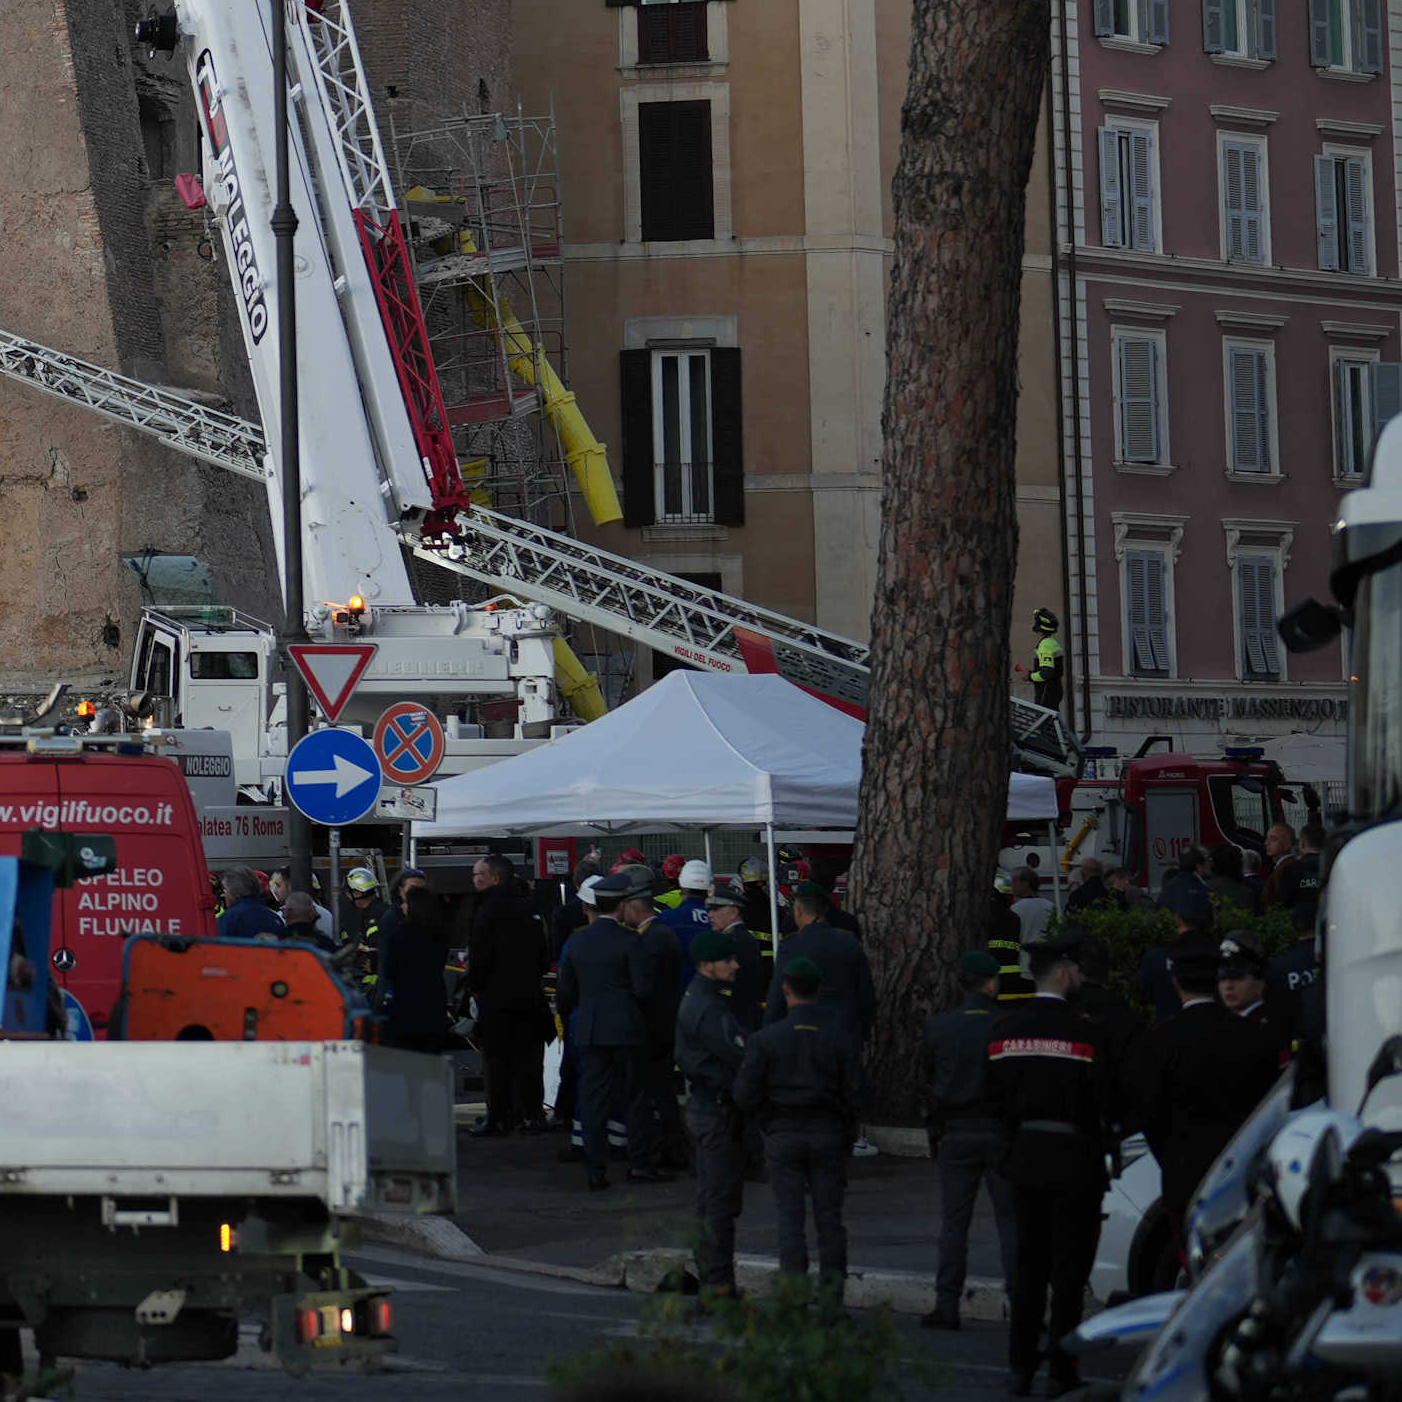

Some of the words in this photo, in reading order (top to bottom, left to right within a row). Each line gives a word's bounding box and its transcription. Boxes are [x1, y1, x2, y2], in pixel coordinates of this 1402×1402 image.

[217, 146, 267, 338] NOLEGGIO
[674, 645, 692, 659] VIGILI
[694, 652, 707, 664] DEL
[708, 658, 731, 672] FUOCO
[1107, 695, 1225, 719] RISTORANTE
[1227, 696, 1333, 719] MASSENZIO
[186, 756, 230, 776] NOLEGGIO
[197, 816, 232, 836] alatea
[235, 816, 249, 835] 76
[253, 816, 284, 836] Roma
[78, 893, 159, 912] ALPINO
[79, 917, 181, 936] FLUVIALE
